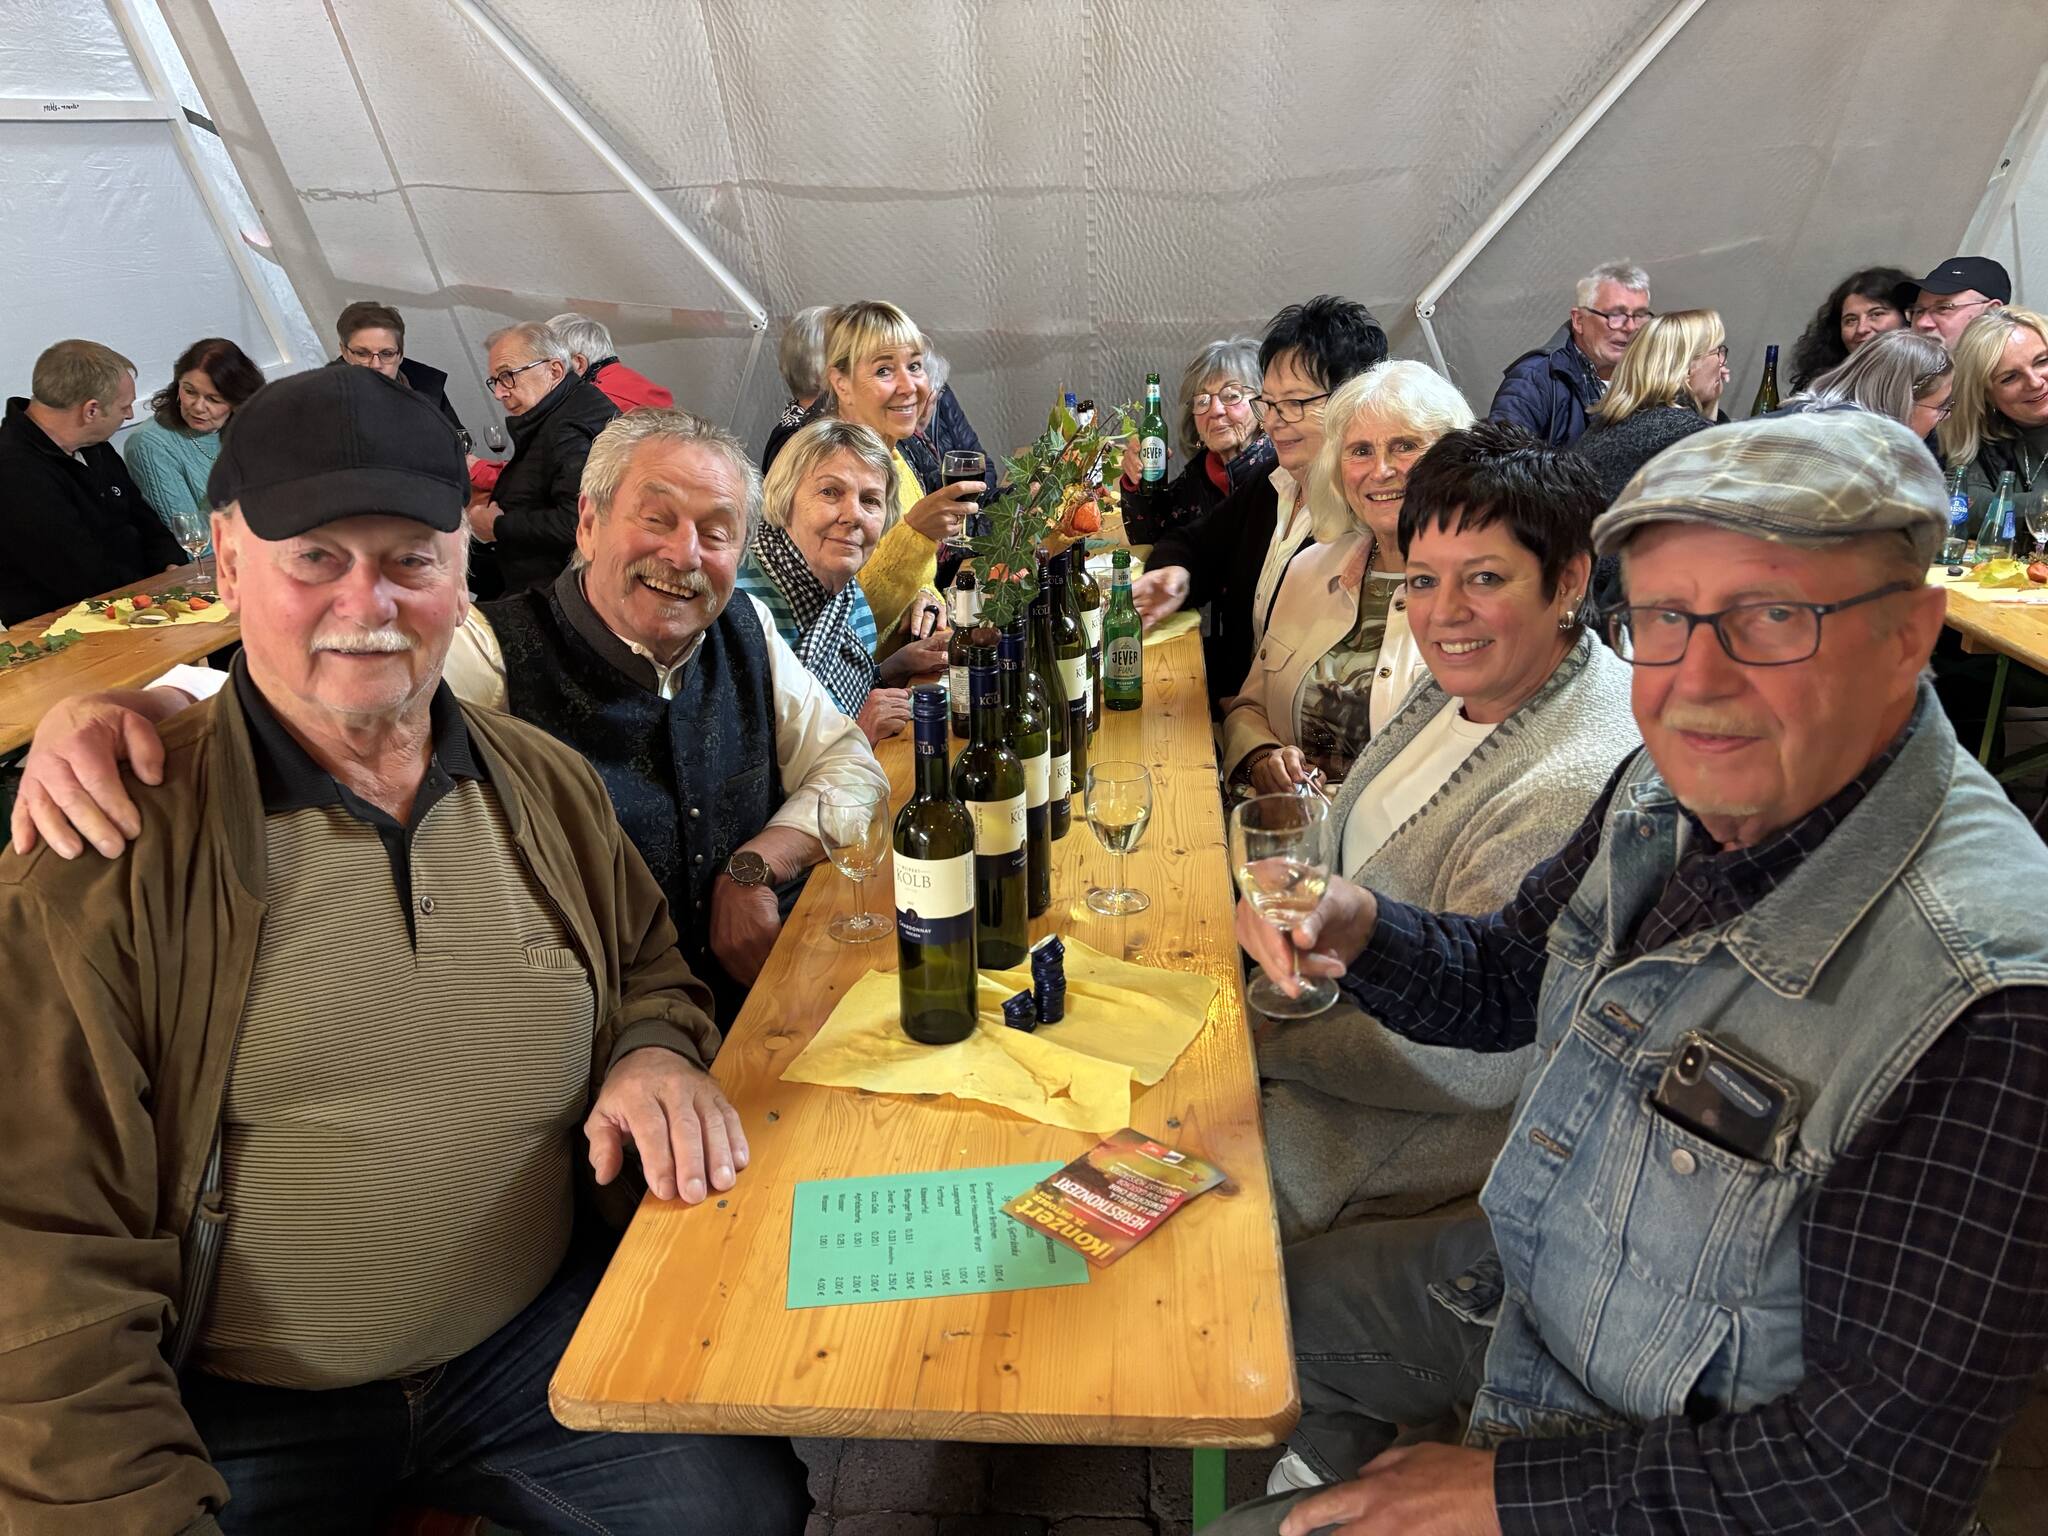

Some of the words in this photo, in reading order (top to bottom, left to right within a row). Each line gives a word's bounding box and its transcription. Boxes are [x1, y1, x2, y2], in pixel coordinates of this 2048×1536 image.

[1142, 446, 1163, 459] JEVER
[1112, 650, 1138, 666] JEVER
[896, 867, 932, 888] KOLB
[1032, 1194, 1074, 1219] OKTOBER
[1052, 1177, 1150, 1230] HERBSTKONZERT
[1015, 1200, 1110, 1256] Konzert
